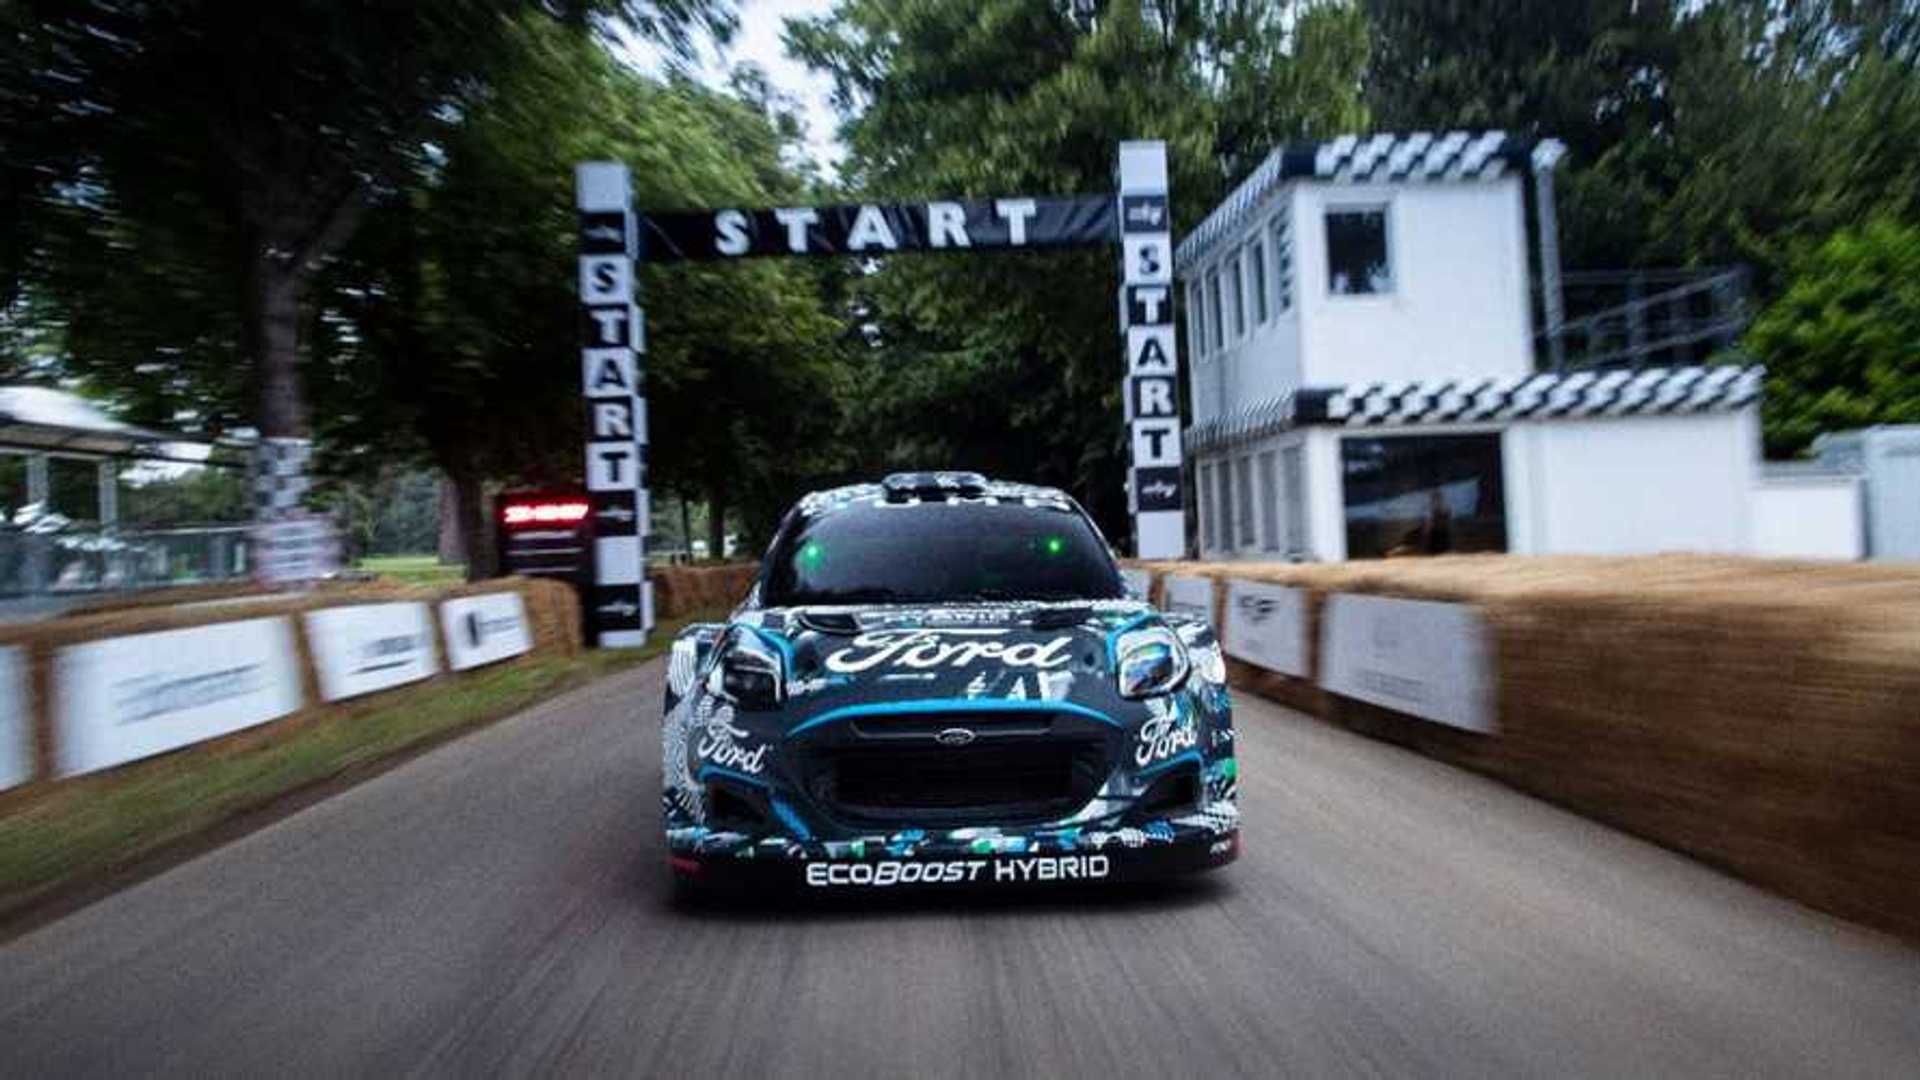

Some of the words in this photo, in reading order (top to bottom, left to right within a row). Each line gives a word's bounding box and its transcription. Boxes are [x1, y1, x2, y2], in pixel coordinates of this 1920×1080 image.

[714, 199, 1037, 255] START
[592, 262, 632, 483] START
[1137, 244, 1173, 459] START
[825, 628, 1073, 673] Ford
[697, 720, 765, 774] Ford
[1135, 716, 1197, 767] Ford
[995, 855, 1109, 881] HYBRID
